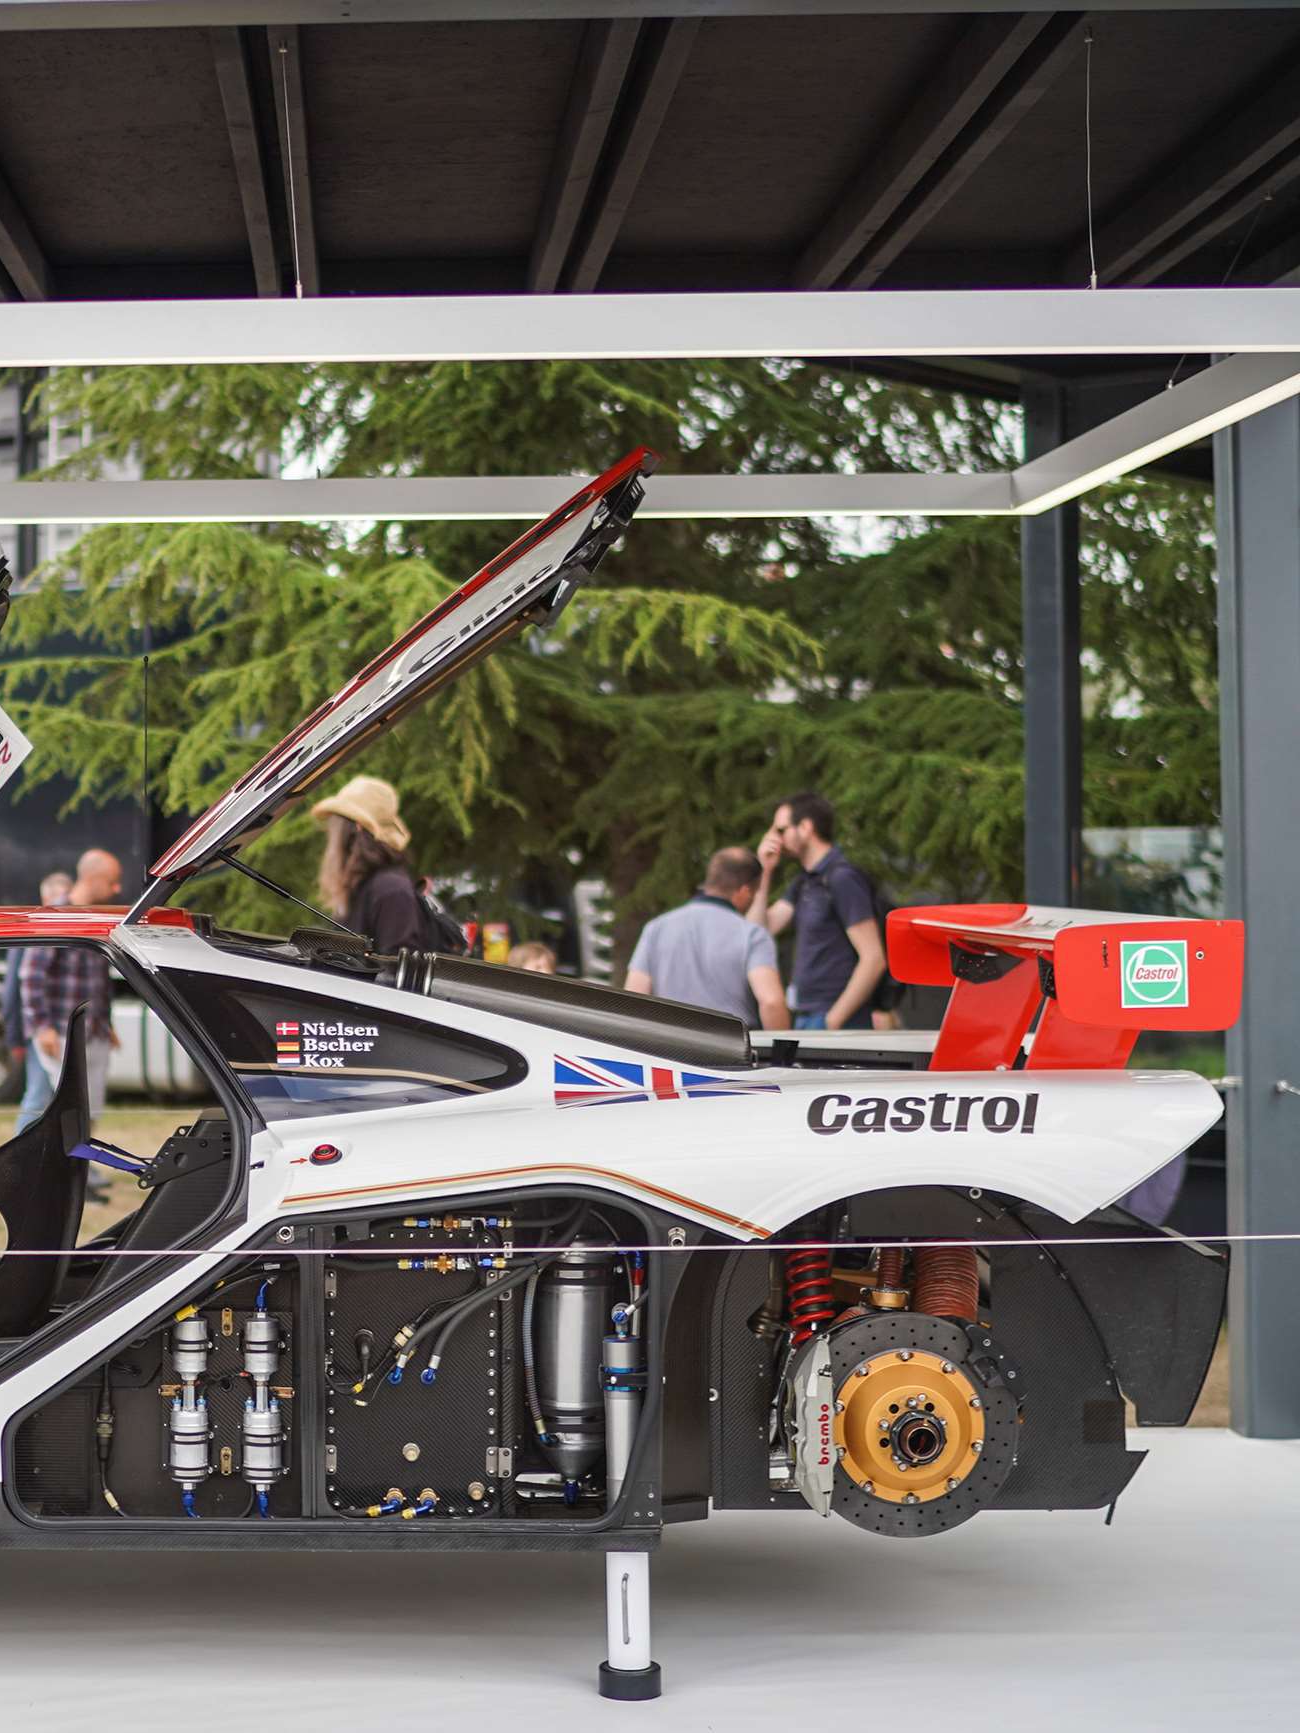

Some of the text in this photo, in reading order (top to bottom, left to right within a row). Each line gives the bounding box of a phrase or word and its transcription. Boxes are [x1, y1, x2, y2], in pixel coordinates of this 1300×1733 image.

[409, 564, 552, 674] Clinic
[1135, 967, 1179, 981] Castrol
[302, 1022, 379, 1037] Nielsen
[303, 1038, 374, 1052] Bscher
[303, 1053, 345, 1068] Kox
[807, 1093, 1039, 1136] Castrol
[818, 1403, 830, 1466] brembo
